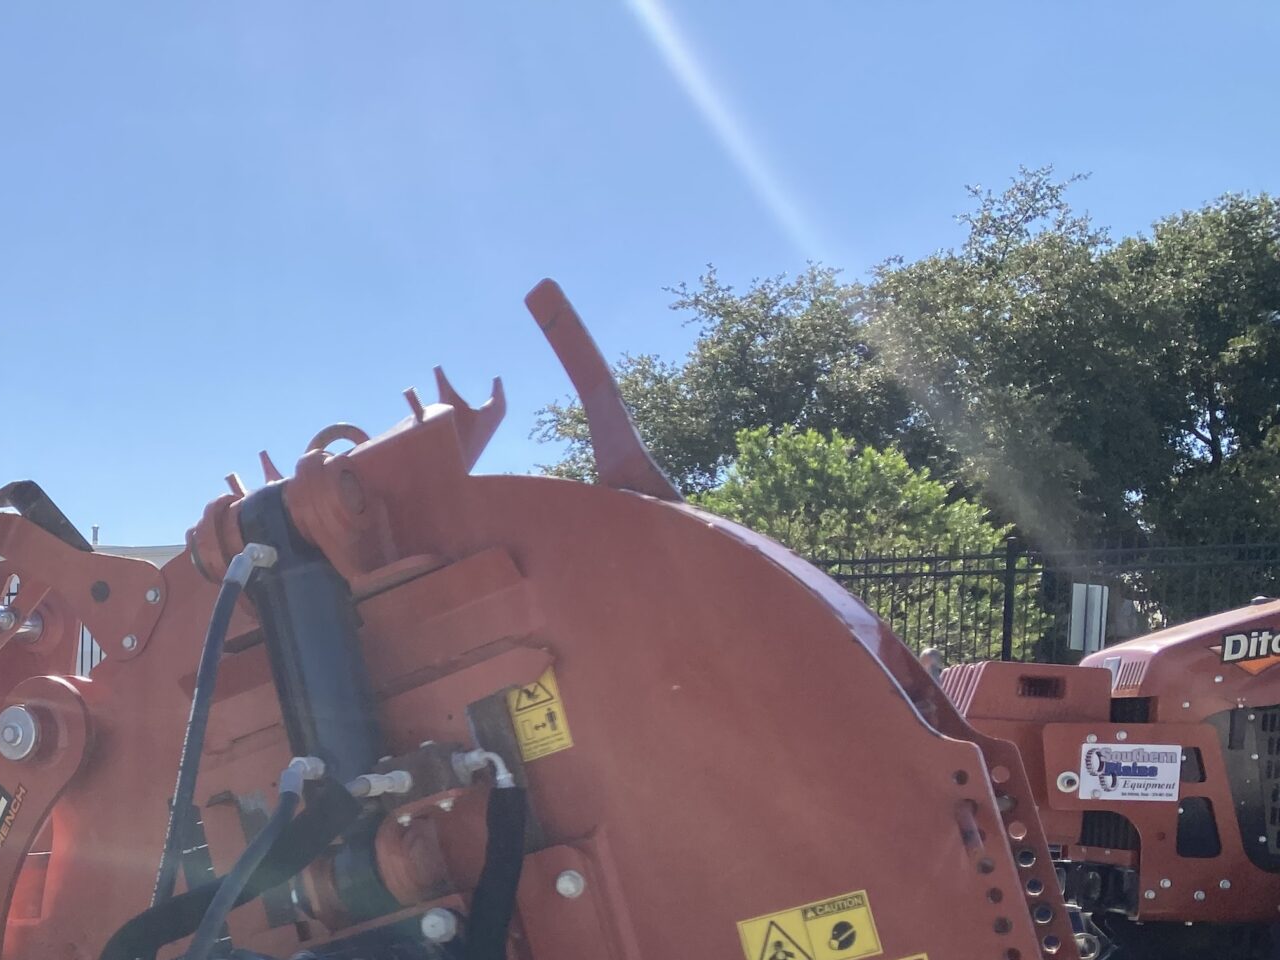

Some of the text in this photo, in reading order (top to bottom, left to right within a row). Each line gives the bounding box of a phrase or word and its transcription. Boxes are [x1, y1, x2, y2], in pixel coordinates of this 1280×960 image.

[1100, 747, 1178, 764] Southern
[1122, 780, 1176, 791] Equipment
[816, 897, 863, 915] CAUTION
